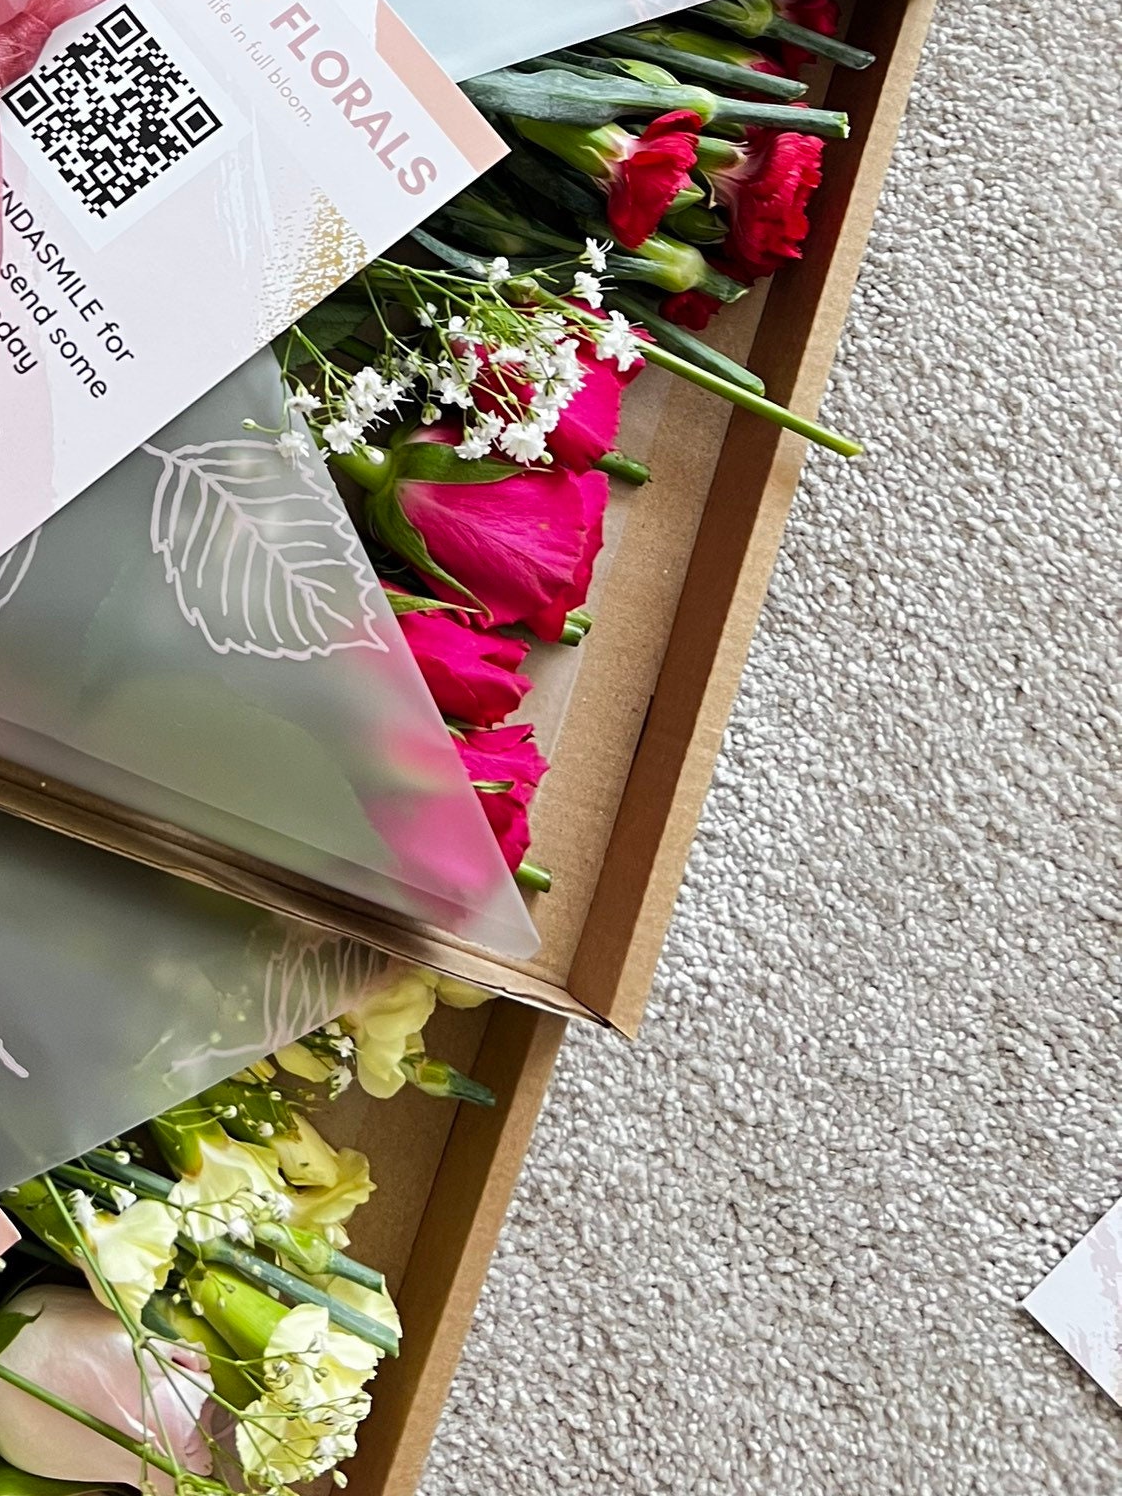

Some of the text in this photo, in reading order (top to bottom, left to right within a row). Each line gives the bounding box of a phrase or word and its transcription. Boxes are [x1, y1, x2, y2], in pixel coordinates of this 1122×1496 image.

[229, 23, 249, 43] in
[245, 41, 274, 70] full
[266, 66, 312, 127] bloom.
[268, 1, 436, 193] FLORALS
[48, 326, 107, 398] some
[96, 322, 134, 361] for
